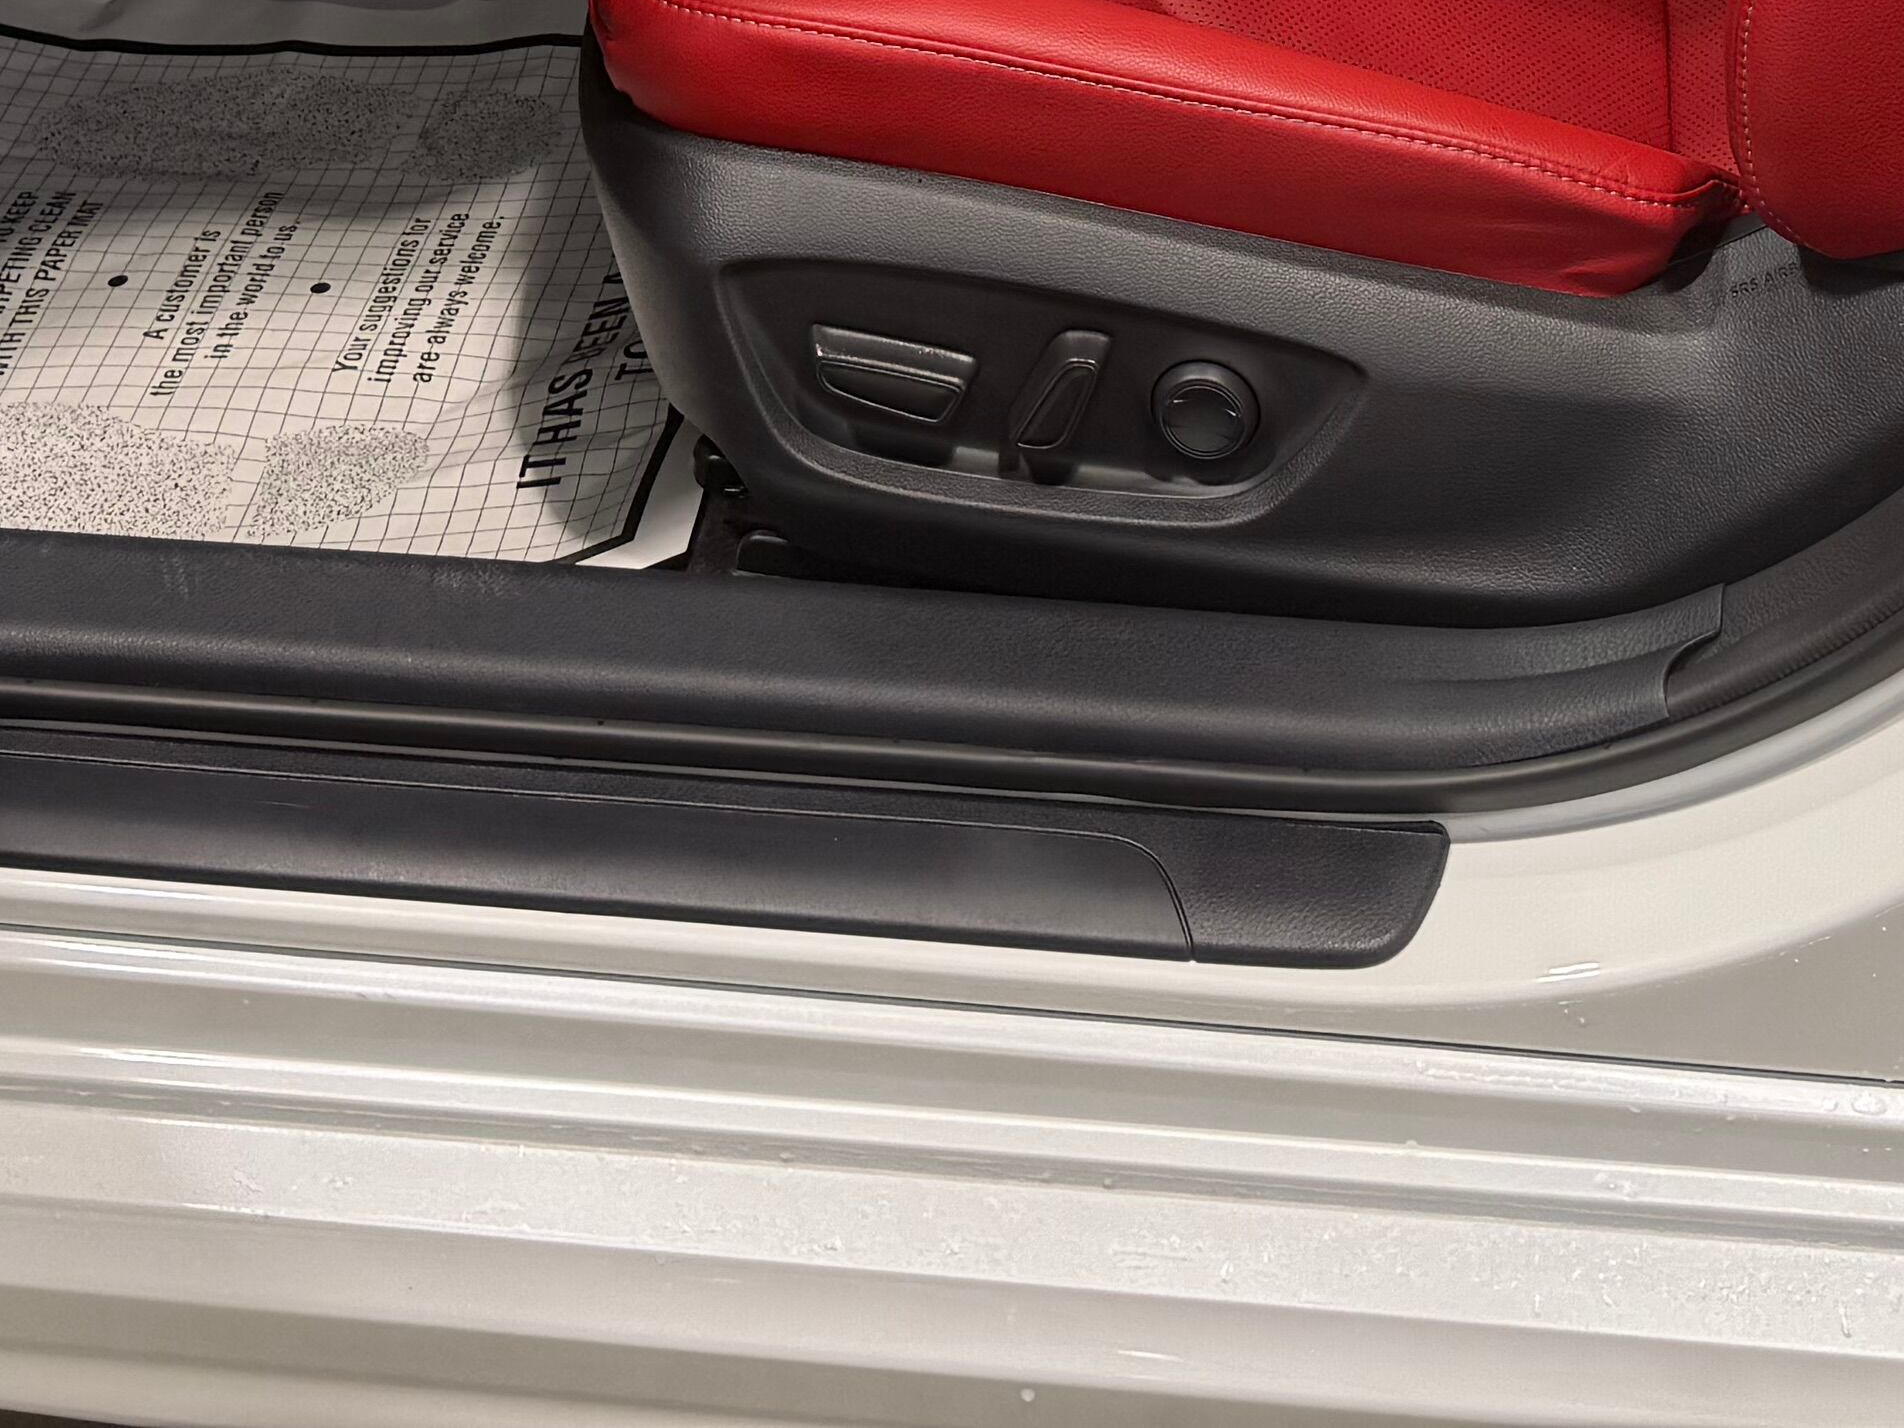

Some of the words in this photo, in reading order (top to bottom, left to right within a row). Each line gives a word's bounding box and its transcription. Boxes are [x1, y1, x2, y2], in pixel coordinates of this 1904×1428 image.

[0, 191, 39, 224] KEEP
[28, 191, 76, 233] CLEAN
[194, 229, 221, 242] is
[260, 245, 286, 261] to
[9, 287, 50, 327] THIS
[34, 229, 82, 281] PAPER
[67, 200, 104, 227] MAT
[155, 246, 211, 323] customer
[235, 262, 276, 307] world
[150, 369, 183, 397] the
[172, 321, 209, 363] most
[191, 239, 255, 315] important
[240, 192, 286, 237] person
[332, 336, 371, 373] Your
[359, 239, 420, 332] suggestions
[401, 217, 432, 237] for
[367, 297, 432, 383] improving
[415, 269, 442, 293] our
[429, 213, 470, 265] service
[142, 327, 169, 340] A
[216, 311, 249, 338] the
[425, 290, 469, 344] always
[204, 343, 234, 359] in
[413, 351, 440, 383] are
[533, 368, 593, 447] HAS
[516, 454, 566, 489] IT
